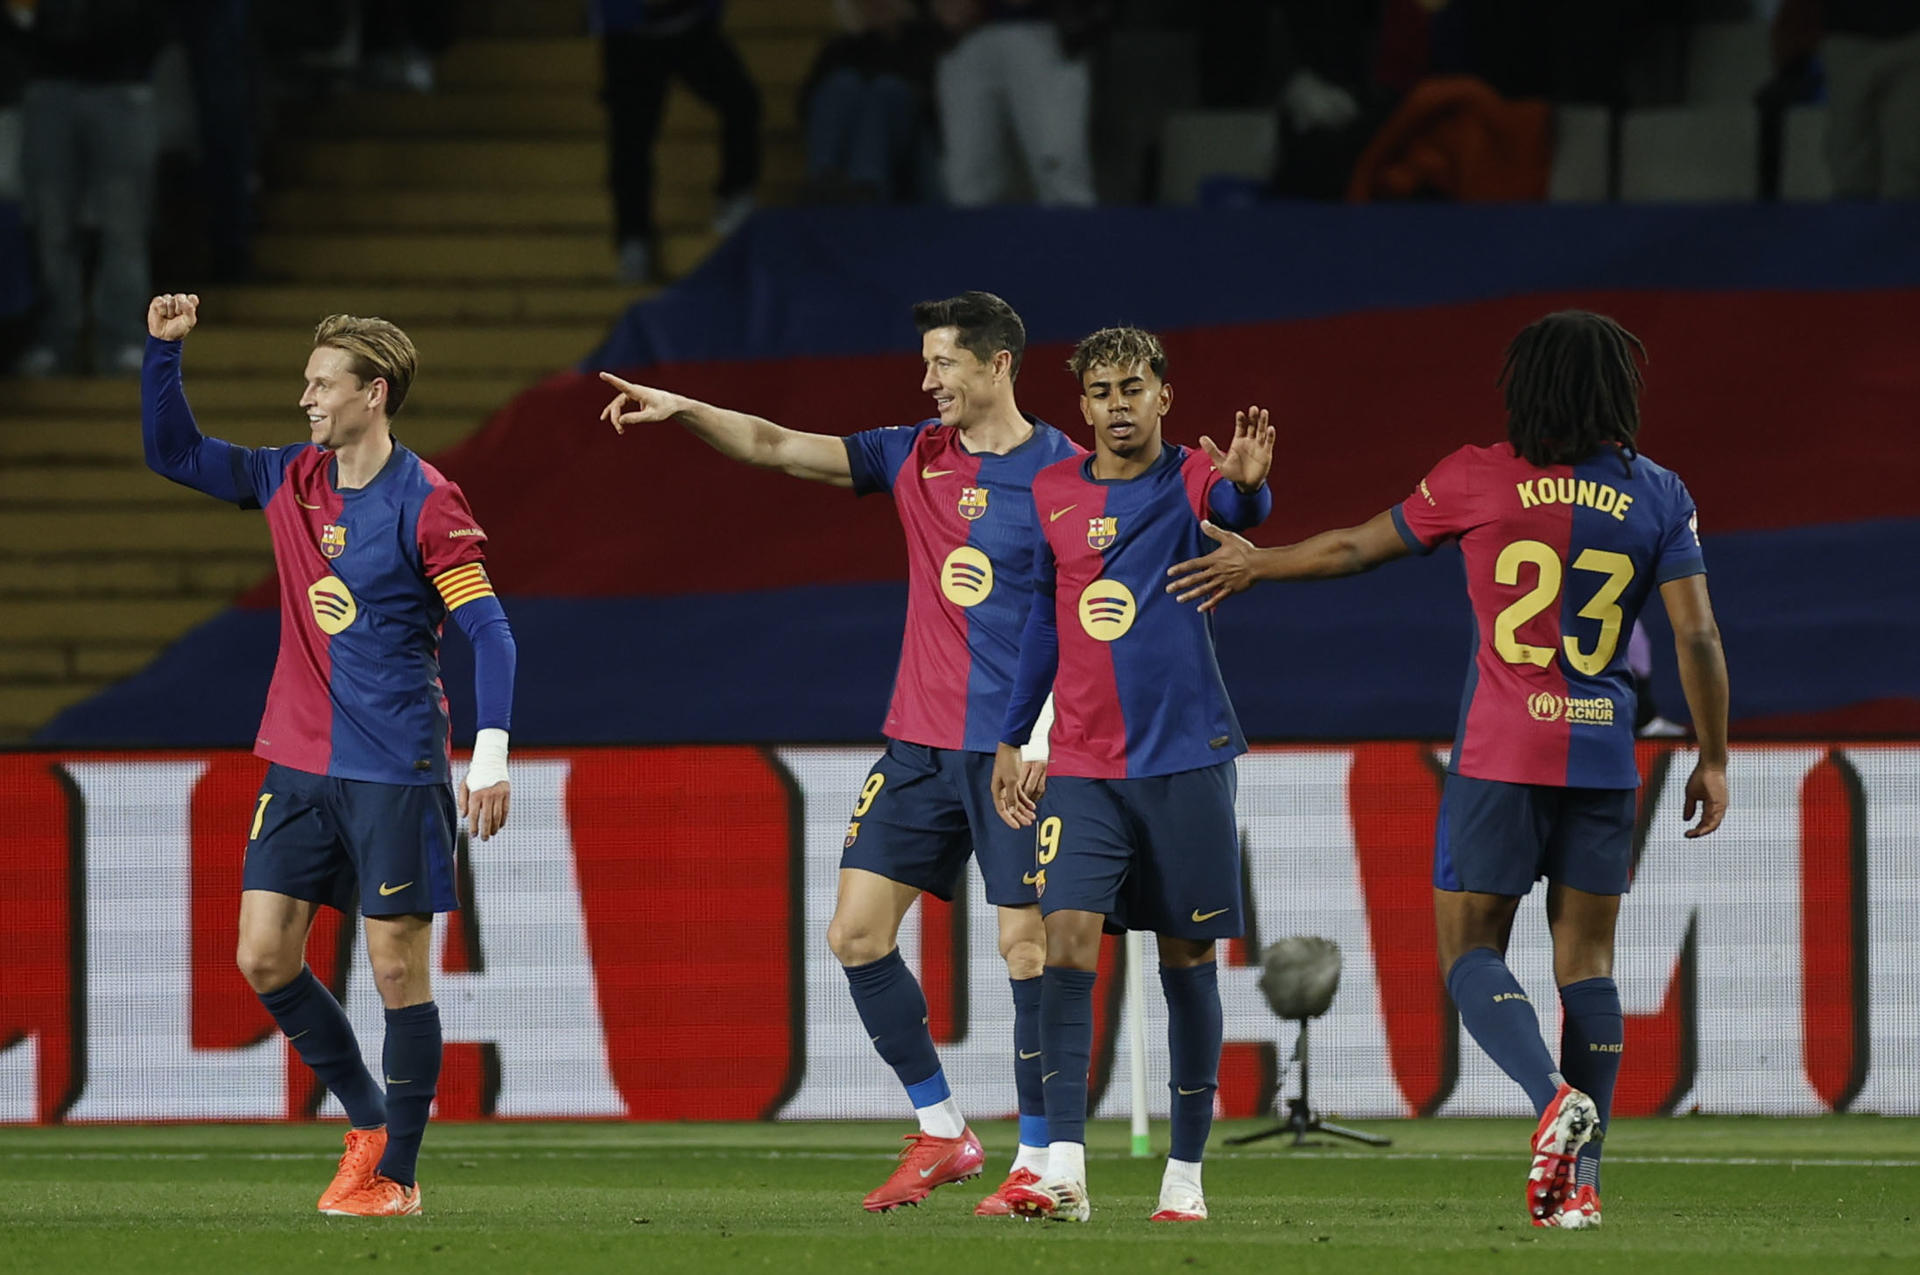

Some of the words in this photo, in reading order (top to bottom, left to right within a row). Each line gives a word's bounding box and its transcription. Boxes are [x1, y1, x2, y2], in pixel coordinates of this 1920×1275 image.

[1516, 477, 1633, 521] KOUNDE
[1494, 540, 1635, 676] 23
[1565, 698, 1614, 709] UNHCR
[1565, 708, 1614, 720] ACNUR
[854, 773, 884, 817] 9
[1037, 816, 1061, 865] 9
